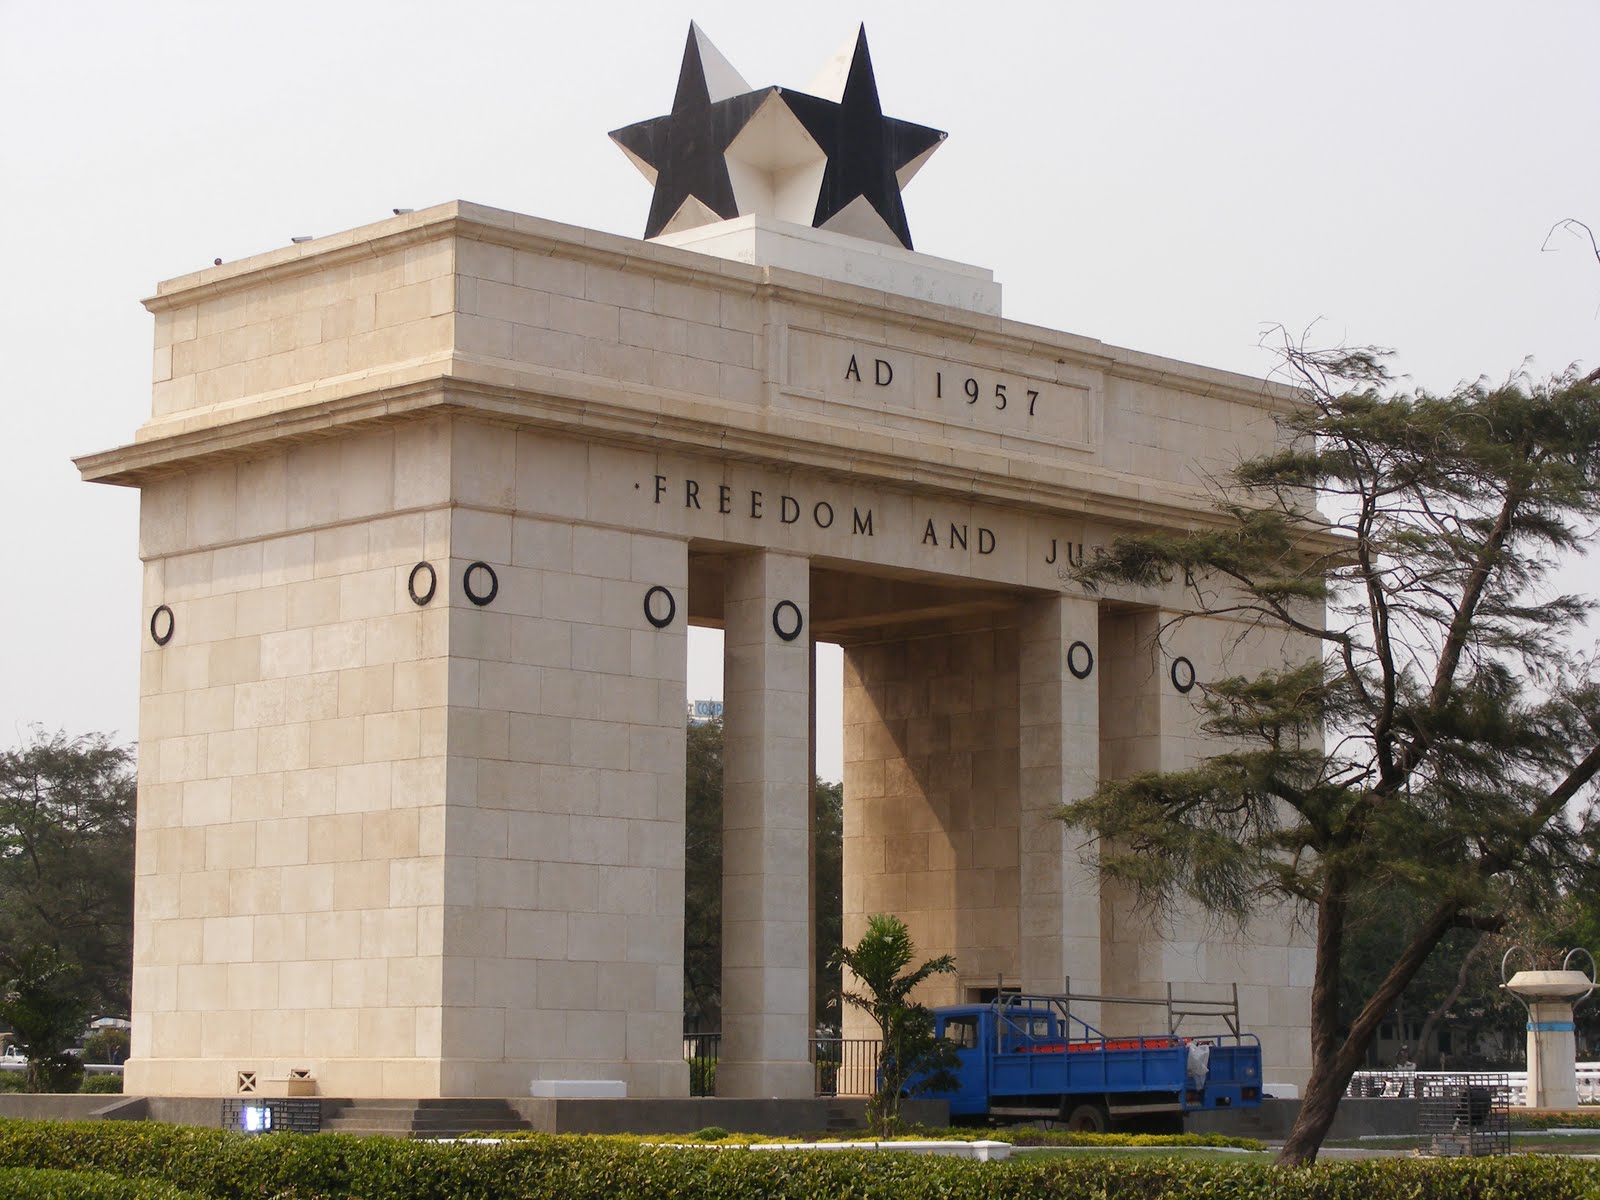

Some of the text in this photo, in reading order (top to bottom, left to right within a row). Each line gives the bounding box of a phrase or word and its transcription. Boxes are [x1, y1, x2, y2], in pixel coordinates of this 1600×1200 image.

[845, 354, 1039, 416] AD 1957
[654, 475, 874, 536] FREEDOM
[922, 518, 996, 555] AND
